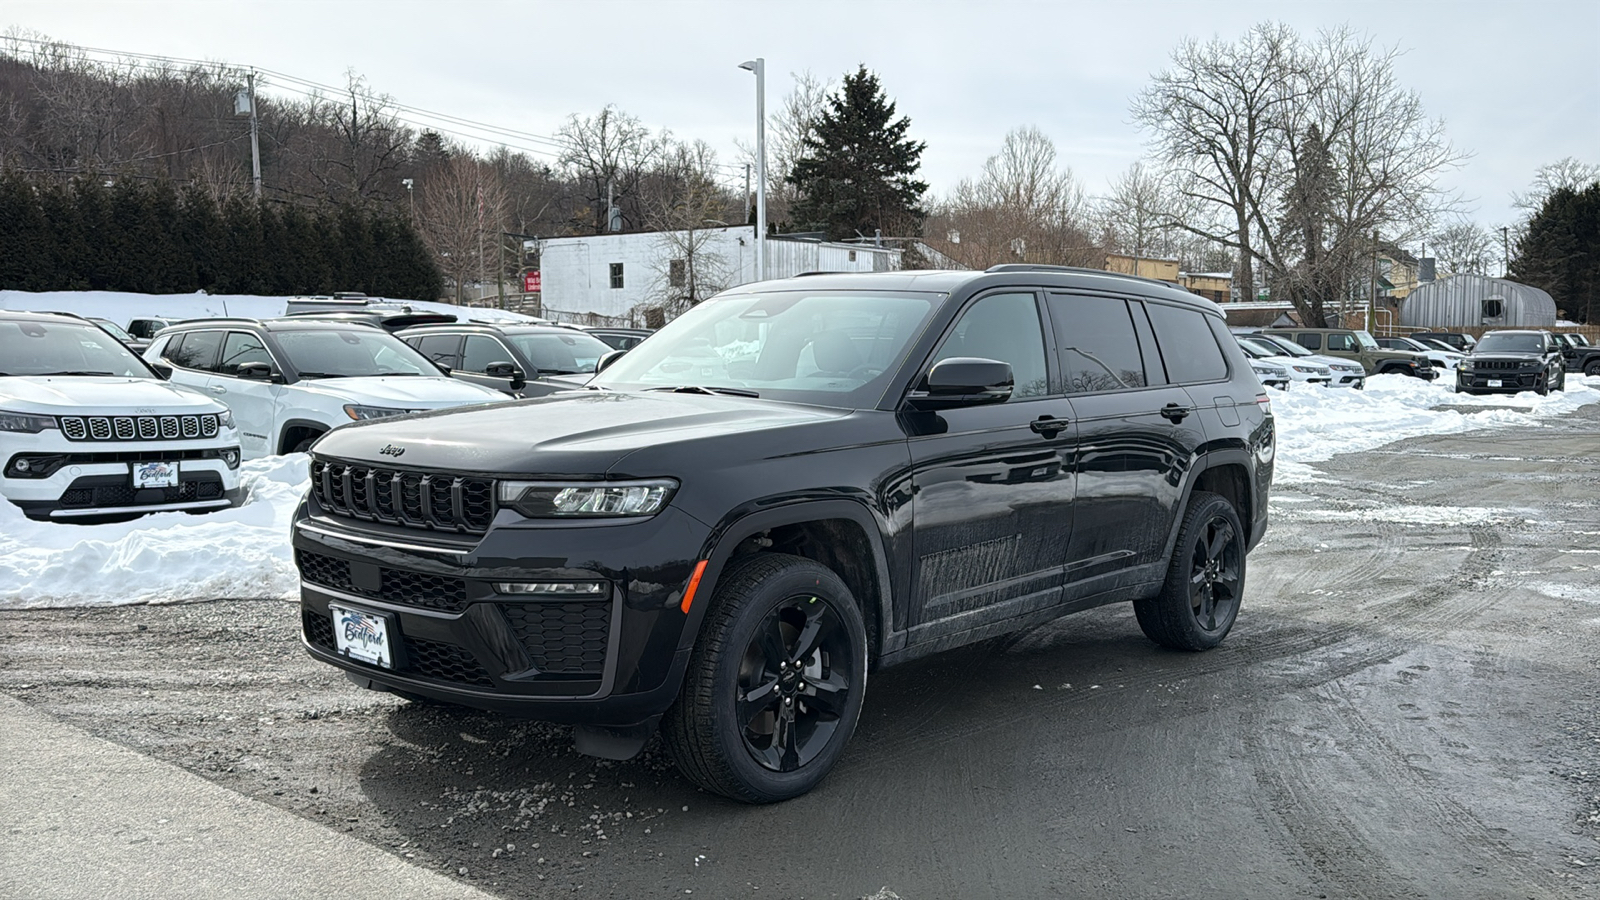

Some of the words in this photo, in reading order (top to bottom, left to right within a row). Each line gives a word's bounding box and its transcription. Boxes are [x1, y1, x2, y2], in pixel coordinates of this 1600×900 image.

[379, 444, 405, 457] Jeep
[139, 467, 173, 482] Bedford
[341, 617, 384, 649] Bedford
